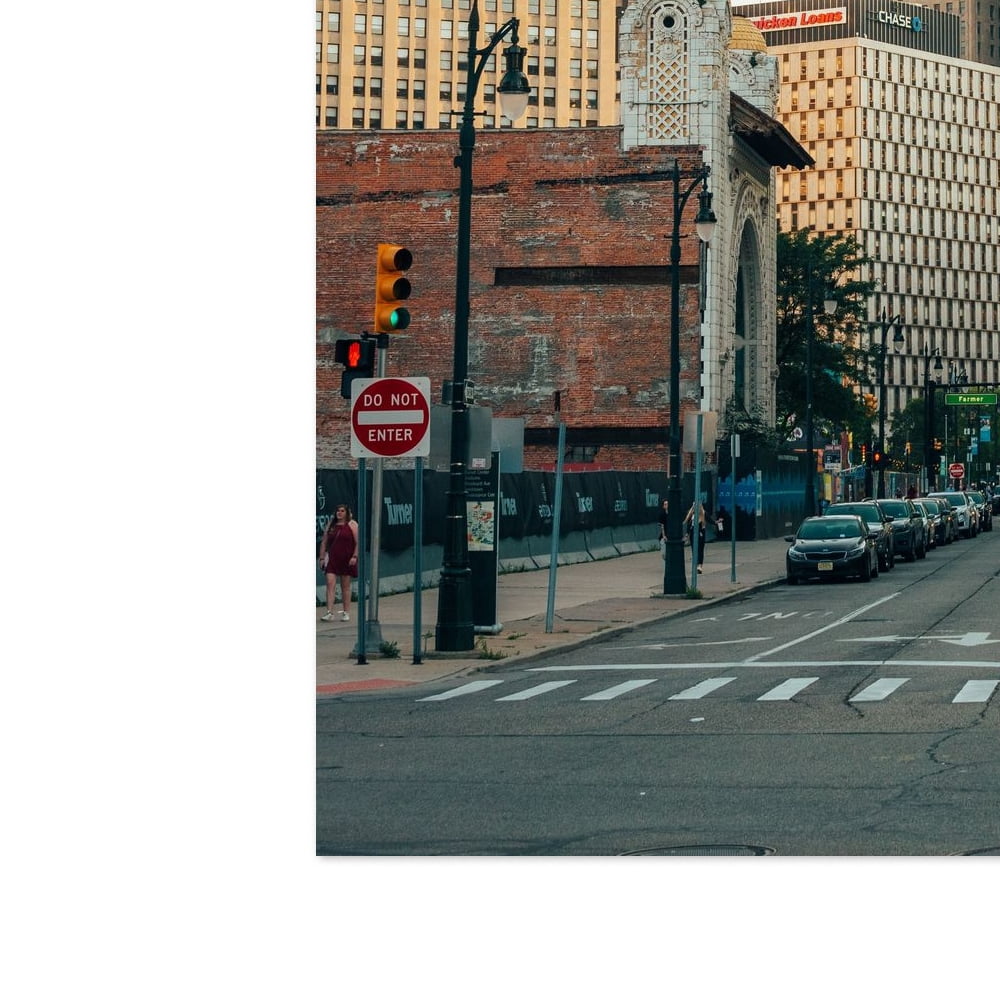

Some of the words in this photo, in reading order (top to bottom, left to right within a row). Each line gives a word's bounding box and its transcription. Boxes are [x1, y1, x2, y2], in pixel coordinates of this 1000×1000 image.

[753, 15, 797, 30] uicken
[800, 10, 842, 25] Loans
[878, 10, 912, 29] CHASE
[364, 394, 382, 407] DO
[391, 393, 419, 406] NOT
[958, 395, 984, 403] Farmer
[368, 428, 413, 442] ENTER
[384, 496, 413, 526] Turner
